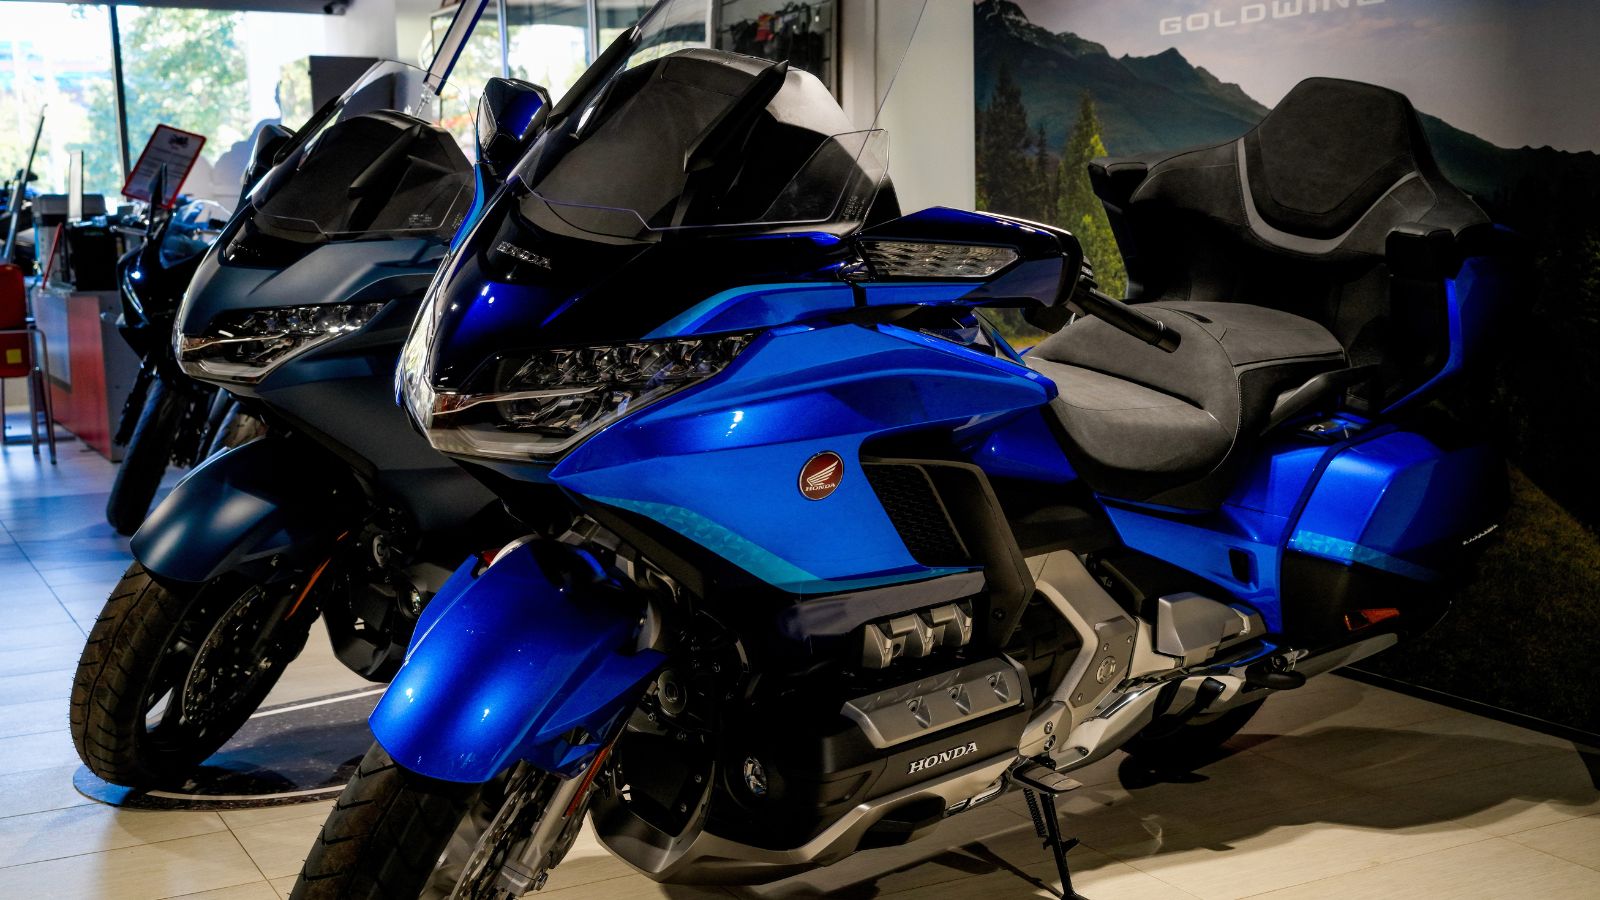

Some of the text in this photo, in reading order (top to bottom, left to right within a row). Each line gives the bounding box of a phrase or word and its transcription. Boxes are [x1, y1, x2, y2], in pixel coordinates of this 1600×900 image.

[1159, 0, 1386, 35] GOLDWIN
[805, 483, 836, 491] HONDA
[908, 742, 978, 774] HONDA
